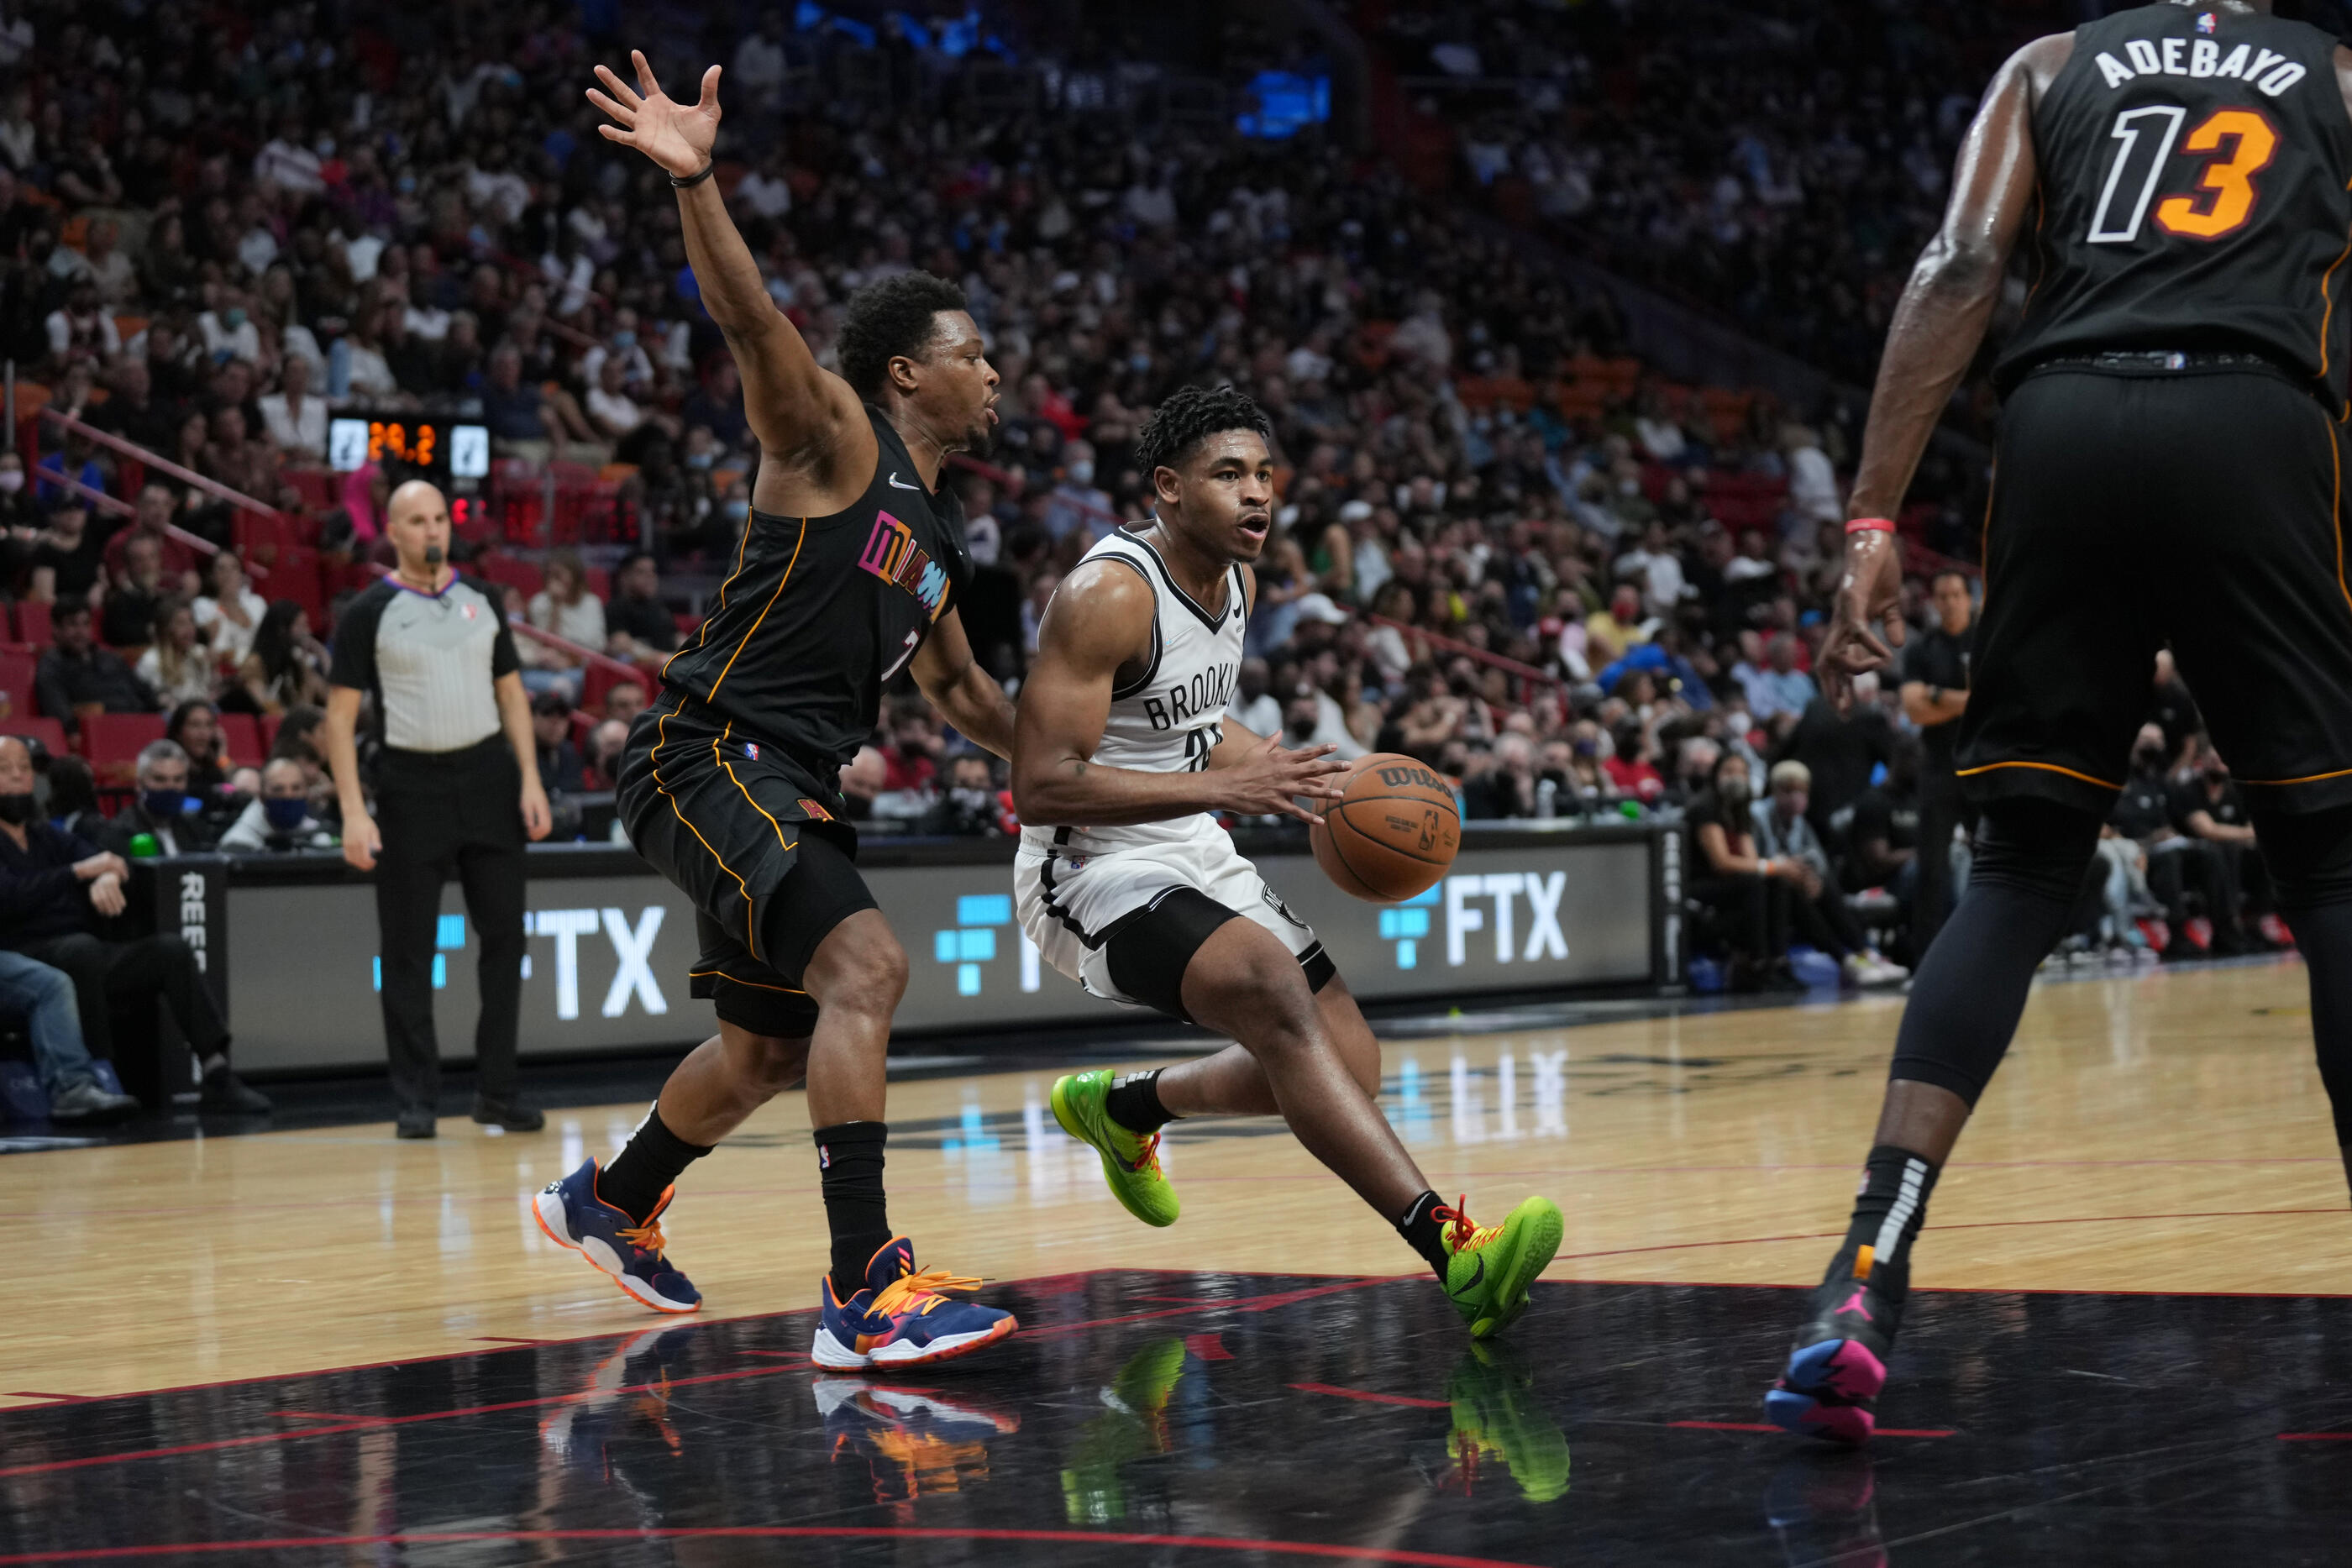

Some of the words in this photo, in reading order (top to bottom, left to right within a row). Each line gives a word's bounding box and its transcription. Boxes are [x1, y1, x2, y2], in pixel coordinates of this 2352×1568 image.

[2095, 37, 2307, 97] ADEBAYO
[2087, 105, 2283, 243] 13
[1375, 766, 1454, 799] Wilso
[520, 905, 669, 1021] TX
[1446, 870, 1569, 967] FTX
